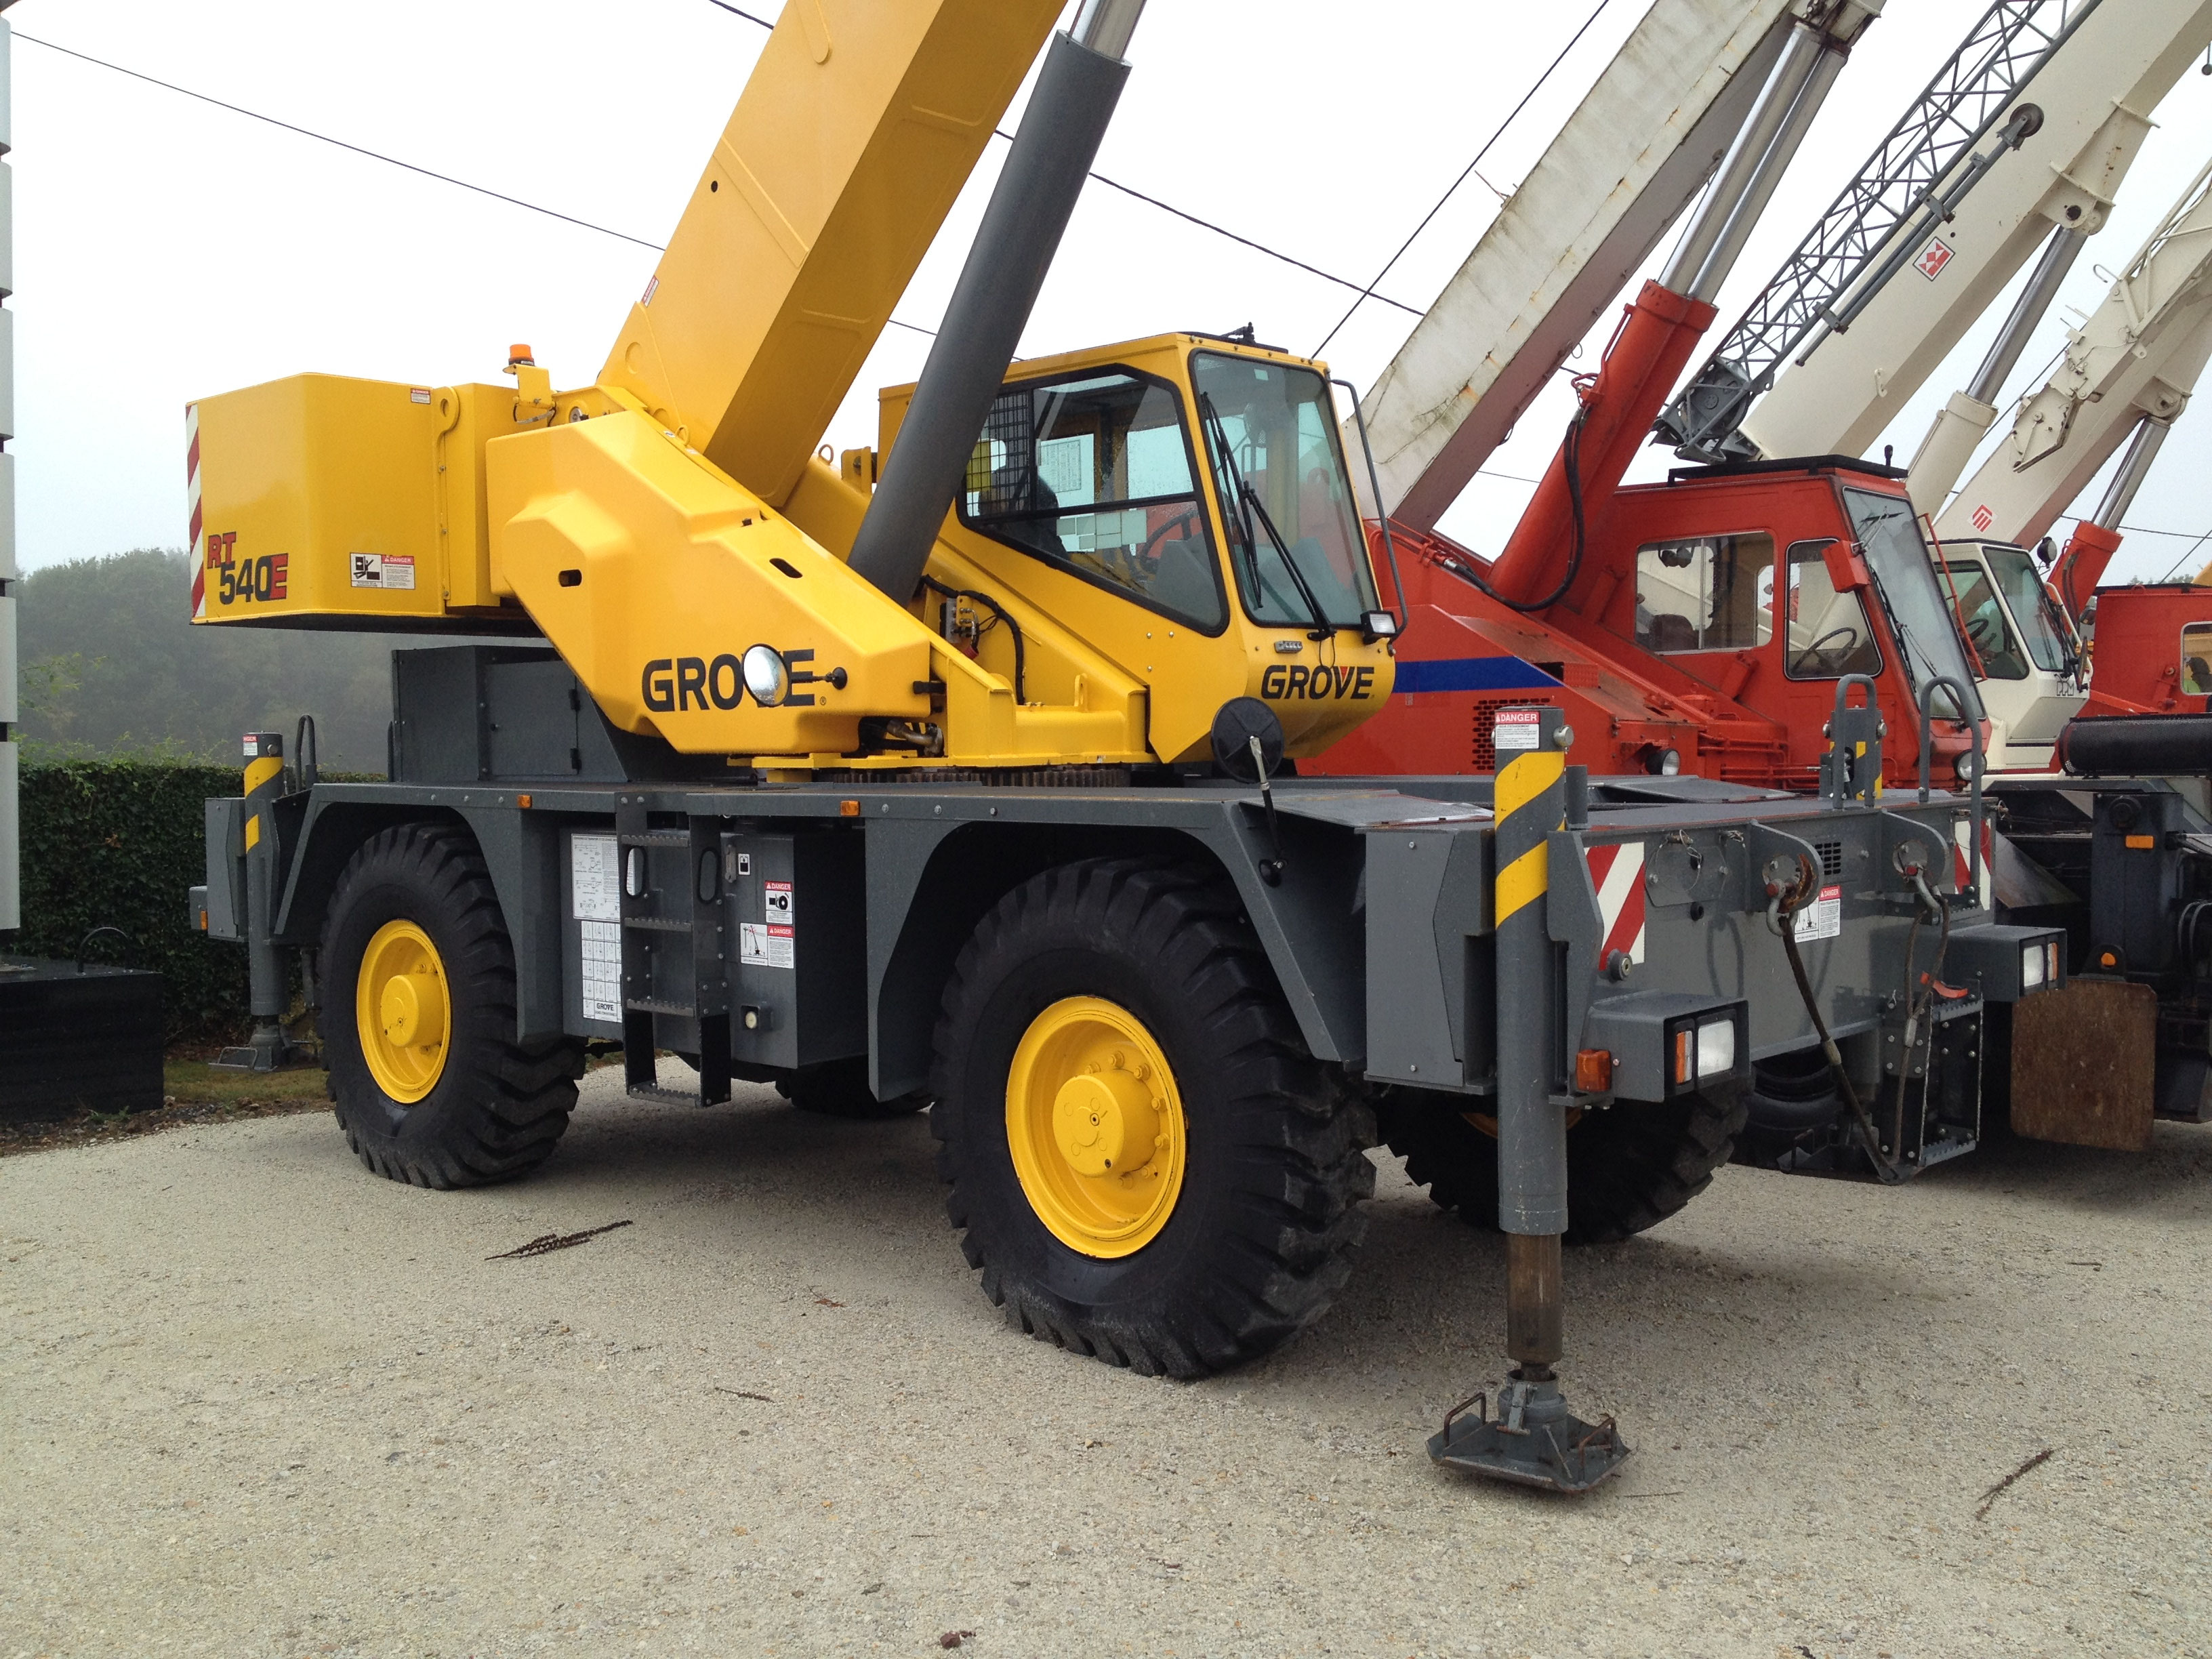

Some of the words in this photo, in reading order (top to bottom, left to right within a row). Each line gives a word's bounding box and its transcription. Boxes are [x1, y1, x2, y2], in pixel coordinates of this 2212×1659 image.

[207, 531, 237, 569] RT
[220, 553, 289, 605] 540E
[642, 649, 815, 712] GROE
[1261, 665, 1374, 699] GROVE
[2056, 680, 2074, 697] PPM
[1500, 713, 1537, 722] DANGER
